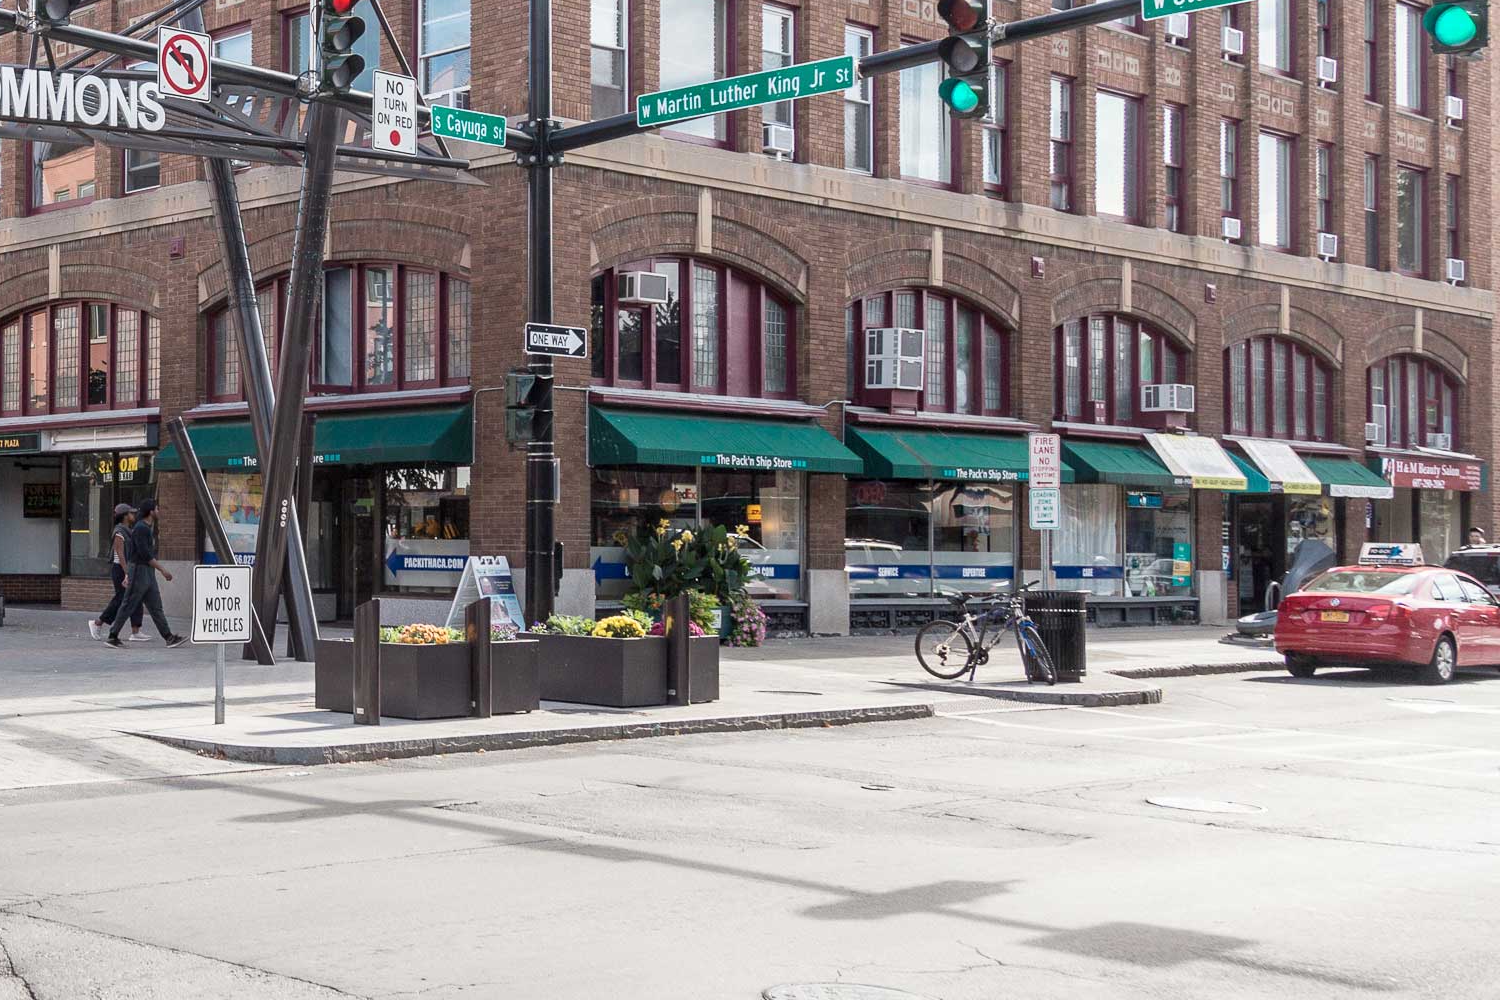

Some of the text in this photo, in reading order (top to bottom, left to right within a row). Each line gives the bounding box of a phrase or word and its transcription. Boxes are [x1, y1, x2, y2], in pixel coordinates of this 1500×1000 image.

[386, 80, 404, 95] NO
[642, 65, 849, 118] W Martin Luther King Jr St
[384, 97, 407, 112] TURN
[377, 112, 412, 129] ON RED
[435, 114, 503, 141] S Cayuga St
[532, 333, 568, 347] ONE WAY
[4, 439, 19, 447] PLAZA
[1035, 437, 1053, 445] FIRE
[1034, 446, 1055, 454] LANE
[243, 457, 257, 466] The
[716, 454, 792, 469] The Pack'n Ship Store
[1039, 457, 1050, 465] NO
[957, 469, 968, 478] The
[988, 471, 1001, 480] Ship
[1002, 472, 1017, 480] Store
[1419, 463, 1441, 478] Beauty
[1442, 465, 1460, 476] Salon
[404, 557, 464, 569] PACKITHACA.COM
[216, 576, 230, 590] NO
[205, 597, 241, 611] MOTOR
[202, 618, 243, 632] VEHICLES
